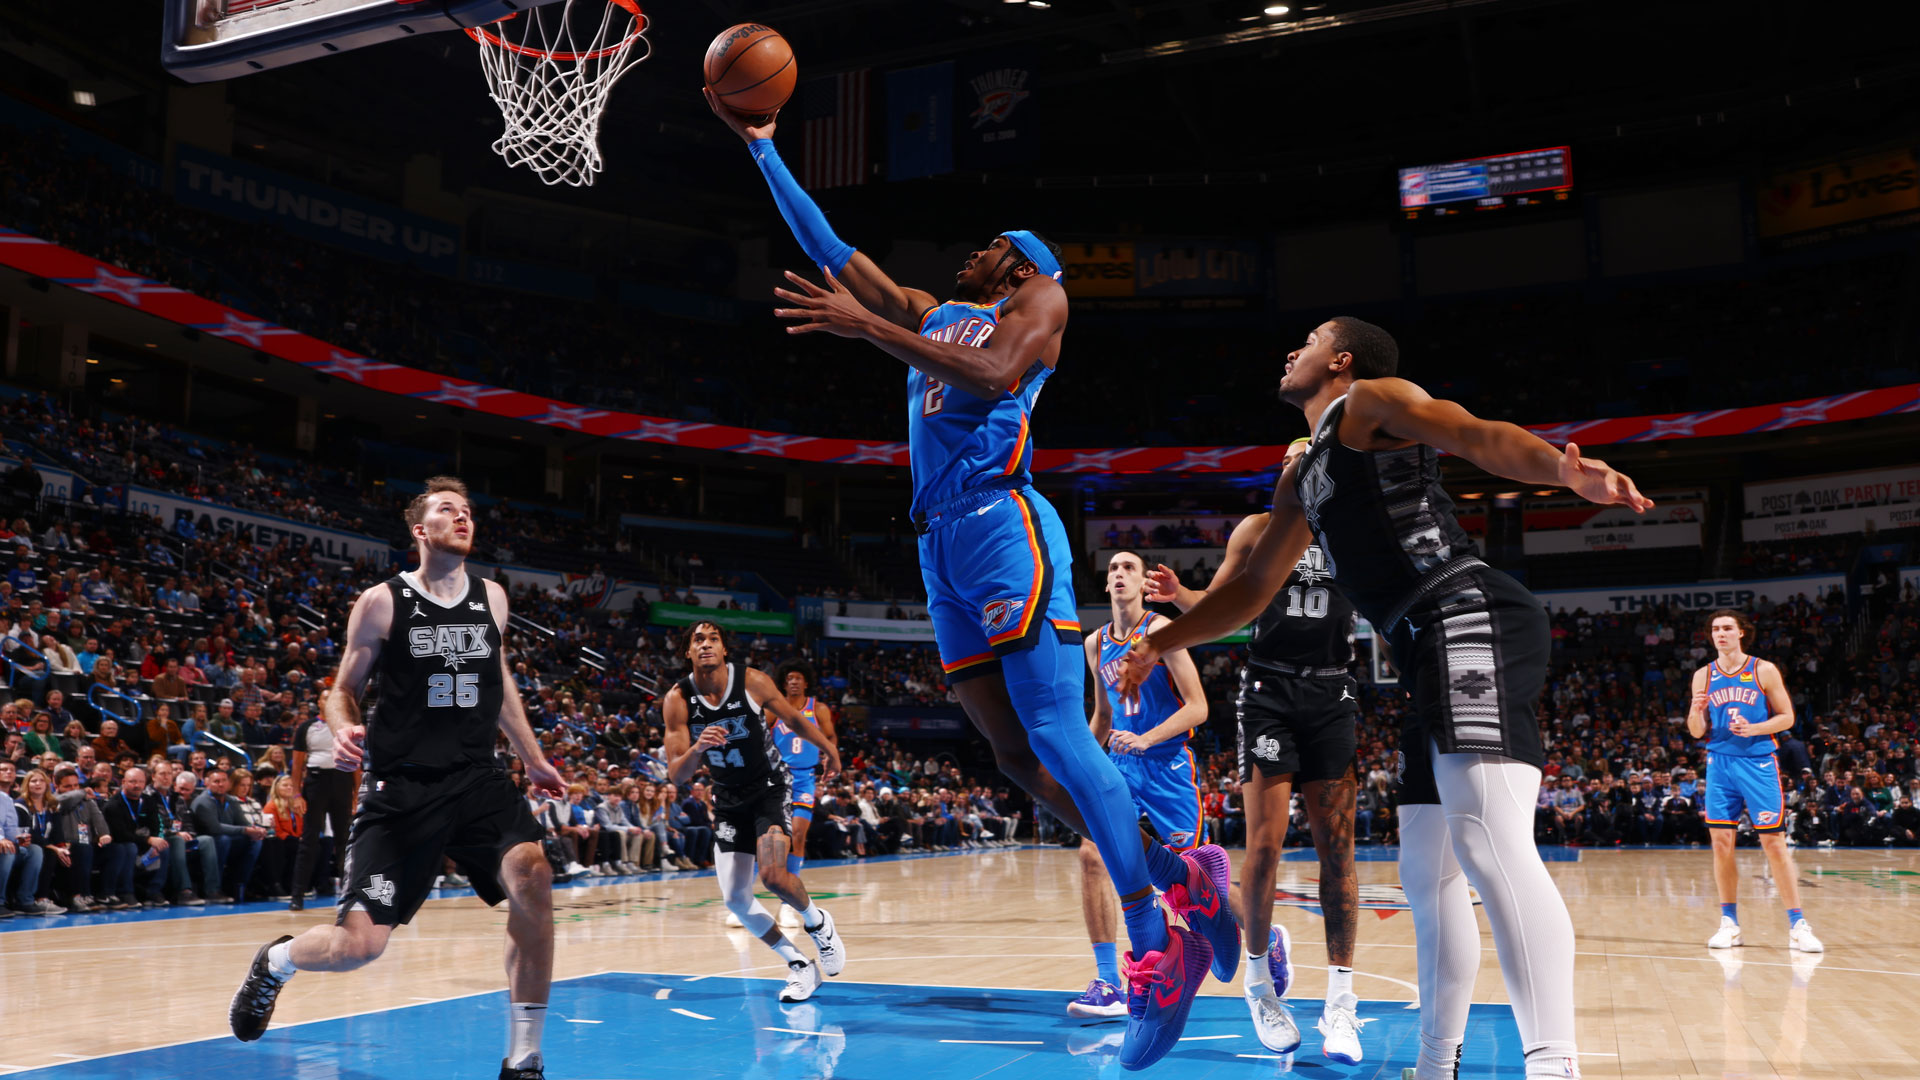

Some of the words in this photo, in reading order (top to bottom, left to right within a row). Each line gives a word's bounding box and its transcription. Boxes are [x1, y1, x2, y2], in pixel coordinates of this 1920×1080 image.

[968, 68, 1028, 95] THUNDER
[180, 160, 396, 246] THUNDER
[401, 224, 457, 258] UP
[922, 375, 946, 418] 2
[44, 482, 67, 504] 06
[1761, 494, 1793, 511] POST
[1813, 488, 1840, 506] OAK
[1845, 483, 1892, 502] PARTY
[1774, 522, 1796, 533] POST
[1809, 519, 1828, 530] OAK
[1890, 510, 1912, 521] POST
[402, 588, 413, 598] 6
[1286, 585, 1329, 619] 10
[1609, 590, 1755, 611] THUNDER
[986, 604, 1005, 627] OKC
[408, 623, 492, 659] SATX
[427, 673, 479, 708] 25
[1709, 686, 1759, 708] THUNDER
[690, 714, 751, 742] STX
[791, 736, 803, 755] 8
[706, 747, 745, 769] 24
